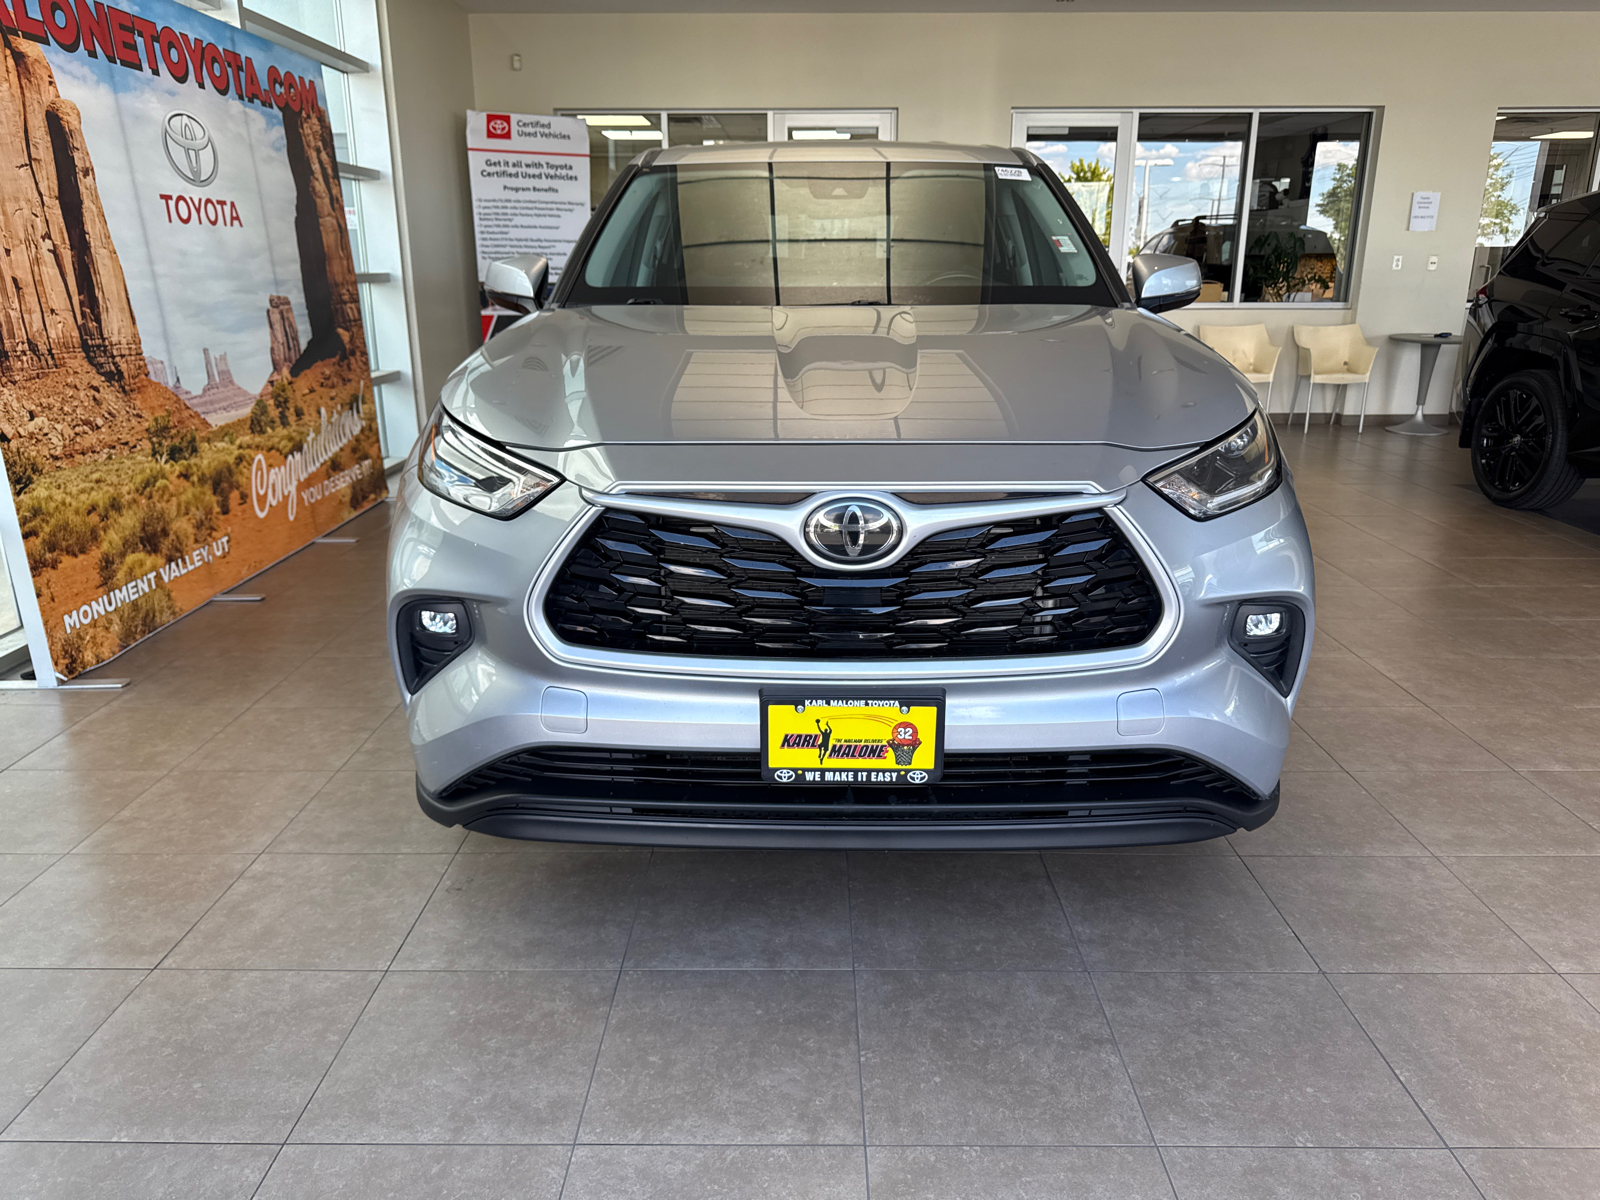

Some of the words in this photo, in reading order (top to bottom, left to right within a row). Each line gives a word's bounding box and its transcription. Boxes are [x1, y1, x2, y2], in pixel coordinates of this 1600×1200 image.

[0, 0, 322, 117] LONETOYOTA.COM
[516, 120, 552, 130] Certified
[516, 129, 538, 139] Used
[539, 130, 571, 141] Vehicles
[485, 158, 502, 168] Get
[503, 159, 510, 168] it
[511, 160, 523, 169] all
[524, 160, 544, 170] with
[545, 162, 573, 172] Toyota
[480, 169, 519, 179] Certified
[520, 171, 543, 180] Used
[544, 171, 578, 182] Vehicles
[503, 185, 532, 194] Program
[533, 185, 559, 194] Benefits
[159, 193, 243, 228] TOYOTA
[251, 379, 366, 521] Congratulations!
[301, 482, 323, 506] YOU
[323, 464, 363, 496] DESERVE
[63, 572, 157, 633] MONUMENT
[159, 545, 214, 585] VALLEY,
[212, 535, 231, 554] UT
[805, 699, 828, 707] KARL
[830, 700, 866, 708] MALONE
[867, 700, 900, 708] TOYOTA
[897, 727, 913, 740] 32
[780, 733, 821, 749] KARL
[827, 744, 889, 760] MALONE
[805, 771, 821, 781] WE
[825, 771, 854, 782] MAKE
[858, 771, 867, 782] IT
[871, 771, 898, 782] EASY
